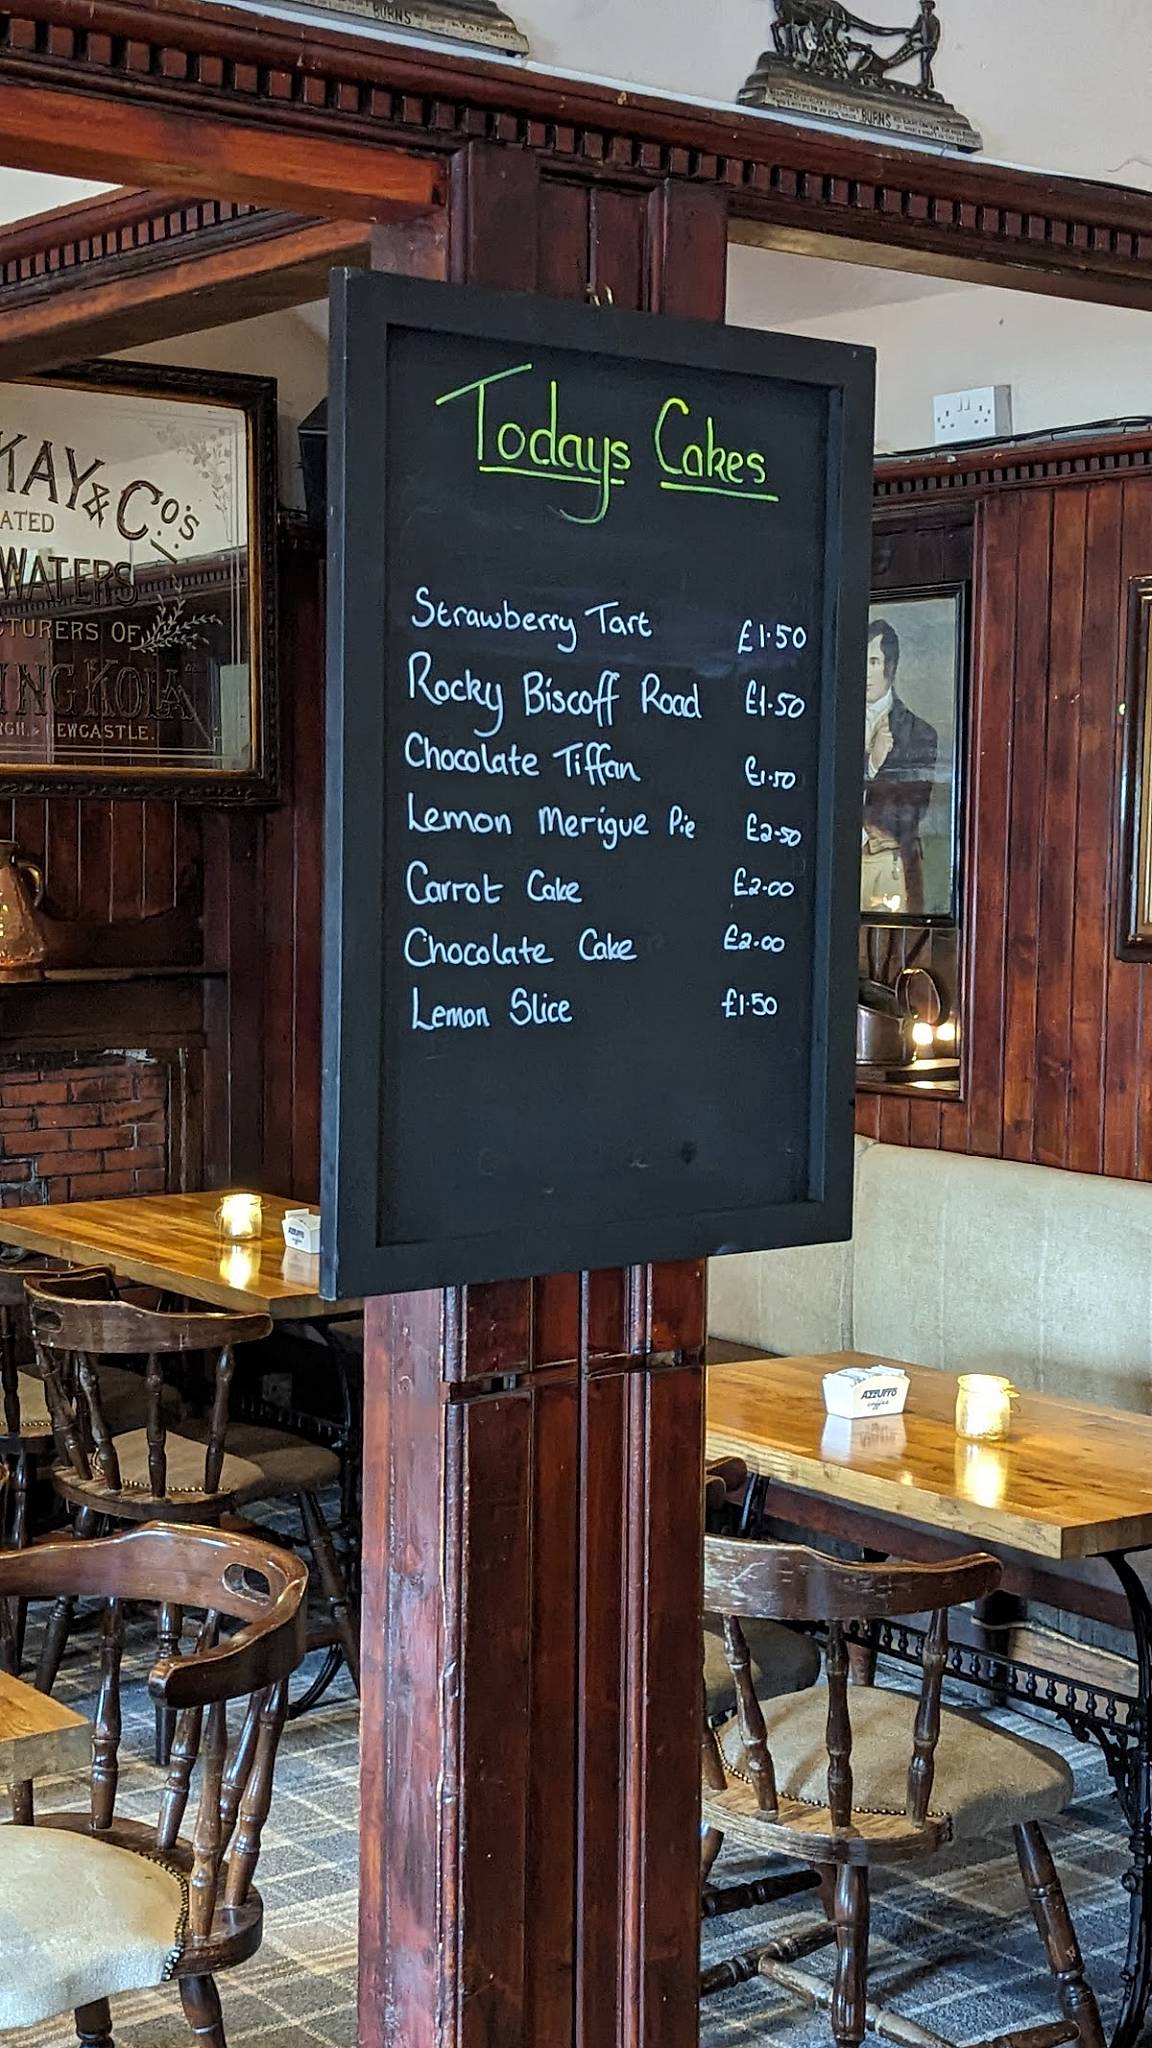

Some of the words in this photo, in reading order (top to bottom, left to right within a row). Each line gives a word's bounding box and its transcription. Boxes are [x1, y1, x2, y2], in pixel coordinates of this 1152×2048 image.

[372, 5, 412, 26] BURNS
[861, 110, 892, 129] BURNS
[436, 363, 631, 523] Todays
[654, 398, 767, 484] Cakes
[0, 509, 55, 533] ATED
[0, 545, 138, 607] WATERS
[0, 618, 99, 641] TURERS
[111, 621, 141, 643] OF
[411, 587, 577, 652] Strawberry
[585, 601, 653, 637] Tart
[737, 620, 807, 654] £1.50
[408, 651, 504, 736] Rocky
[523, 670, 620, 727] Biscoff
[641, 673, 702, 719] Road
[745, 680, 806, 719] £1.50
[404, 731, 540, 777] Chocolate
[408, 792, 512, 835] Lemon
[538, 806, 650, 850] Merigue
[669, 804, 696, 839] Pie
[746, 813, 802, 847] £2.50
[406, 861, 504, 905] Carrot
[527, 869, 583, 904] Cake
[733, 867, 795, 897] £2.00
[403, 927, 555, 967] Chocolate
[578, 927, 638, 962] Cake
[723, 923, 786, 953] £2.00
[412, 986, 490, 1031] Lemon
[509, 987, 573, 1026] Slice
[721, 987, 778, 1018] £1.50
